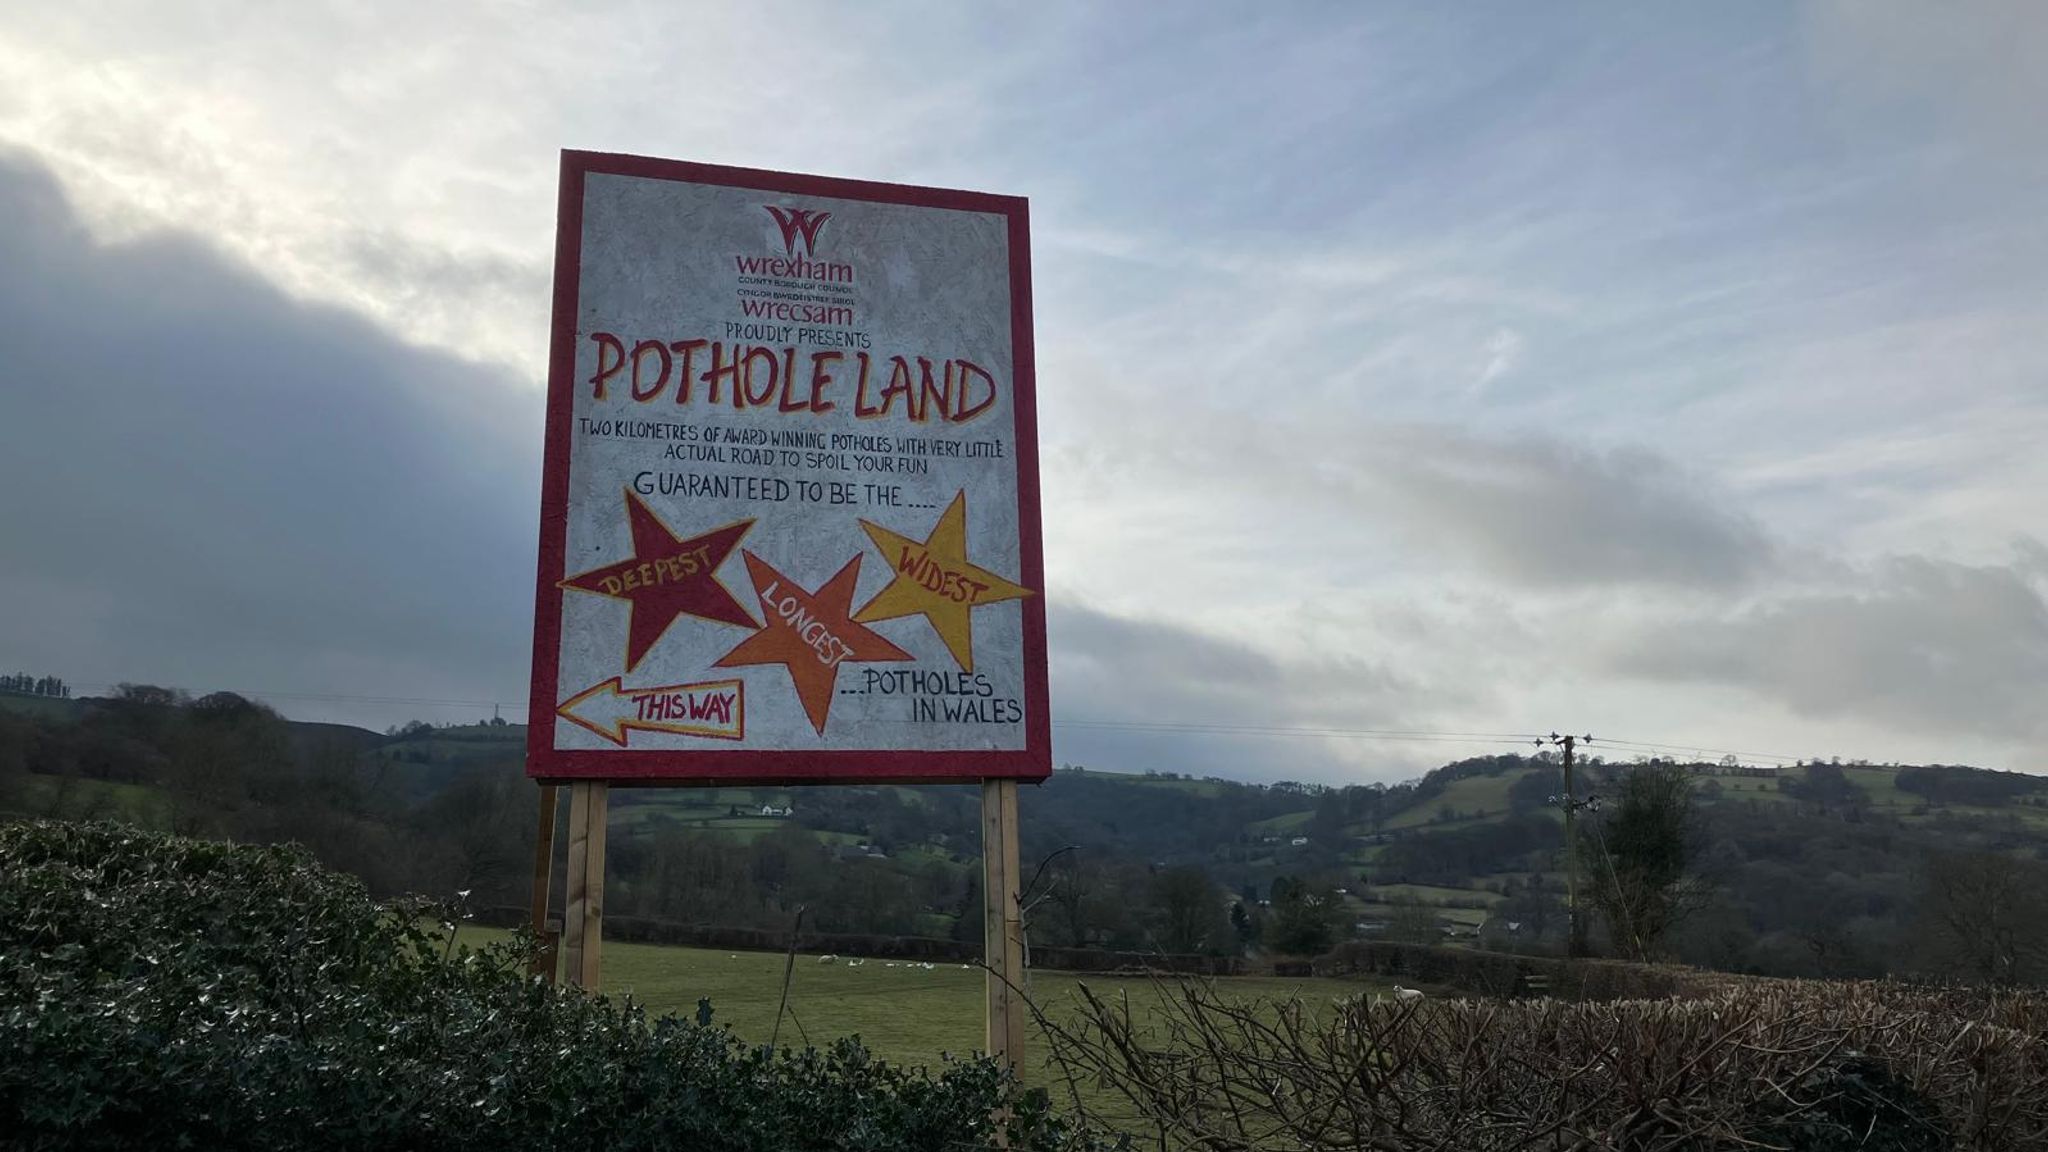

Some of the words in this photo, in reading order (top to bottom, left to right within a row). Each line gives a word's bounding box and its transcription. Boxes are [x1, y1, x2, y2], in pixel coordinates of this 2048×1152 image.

[736, 252, 853, 283] wrexham
[738, 276, 772, 286] COUNTY
[741, 299, 853, 326] wrecsam
[726, 322, 793, 343] PROUDLY
[798, 328, 872, 349] PRESENTS
[579, 418, 612, 435] TWO
[615, 420, 699, 441] KILOMETRES
[704, 427, 721, 442] OF
[723, 428, 767, 445] AWARD
[770, 430, 826, 450] WINNING
[832, 434, 893, 453] POTHOLES
[897, 438, 926, 456] WITH
[930, 439, 961, 457] VERY
[966, 440, 1004, 458] LITTLE
[664, 444, 726, 463] ACTUAL
[731, 448, 774, 466] ROAD
[780, 450, 800, 466] TO
[806, 452, 849, 471] SPOIL
[853, 455, 894, 473] YOUR
[898, 458, 928, 474] FUN
[633, 471, 790, 501] GUARANTEED
[796, 480, 823, 502] TO
[830, 482, 857, 505] BE
[600, 547, 711, 596] DEEPEST
[899, 546, 989, 602] WIDEST
[761, 581, 855, 669] LONGEST
[632, 694, 686, 721] THIS
[687, 692, 738, 725] WAY
[913, 699, 936, 723] IN
[943, 699, 1023, 724] WALES
